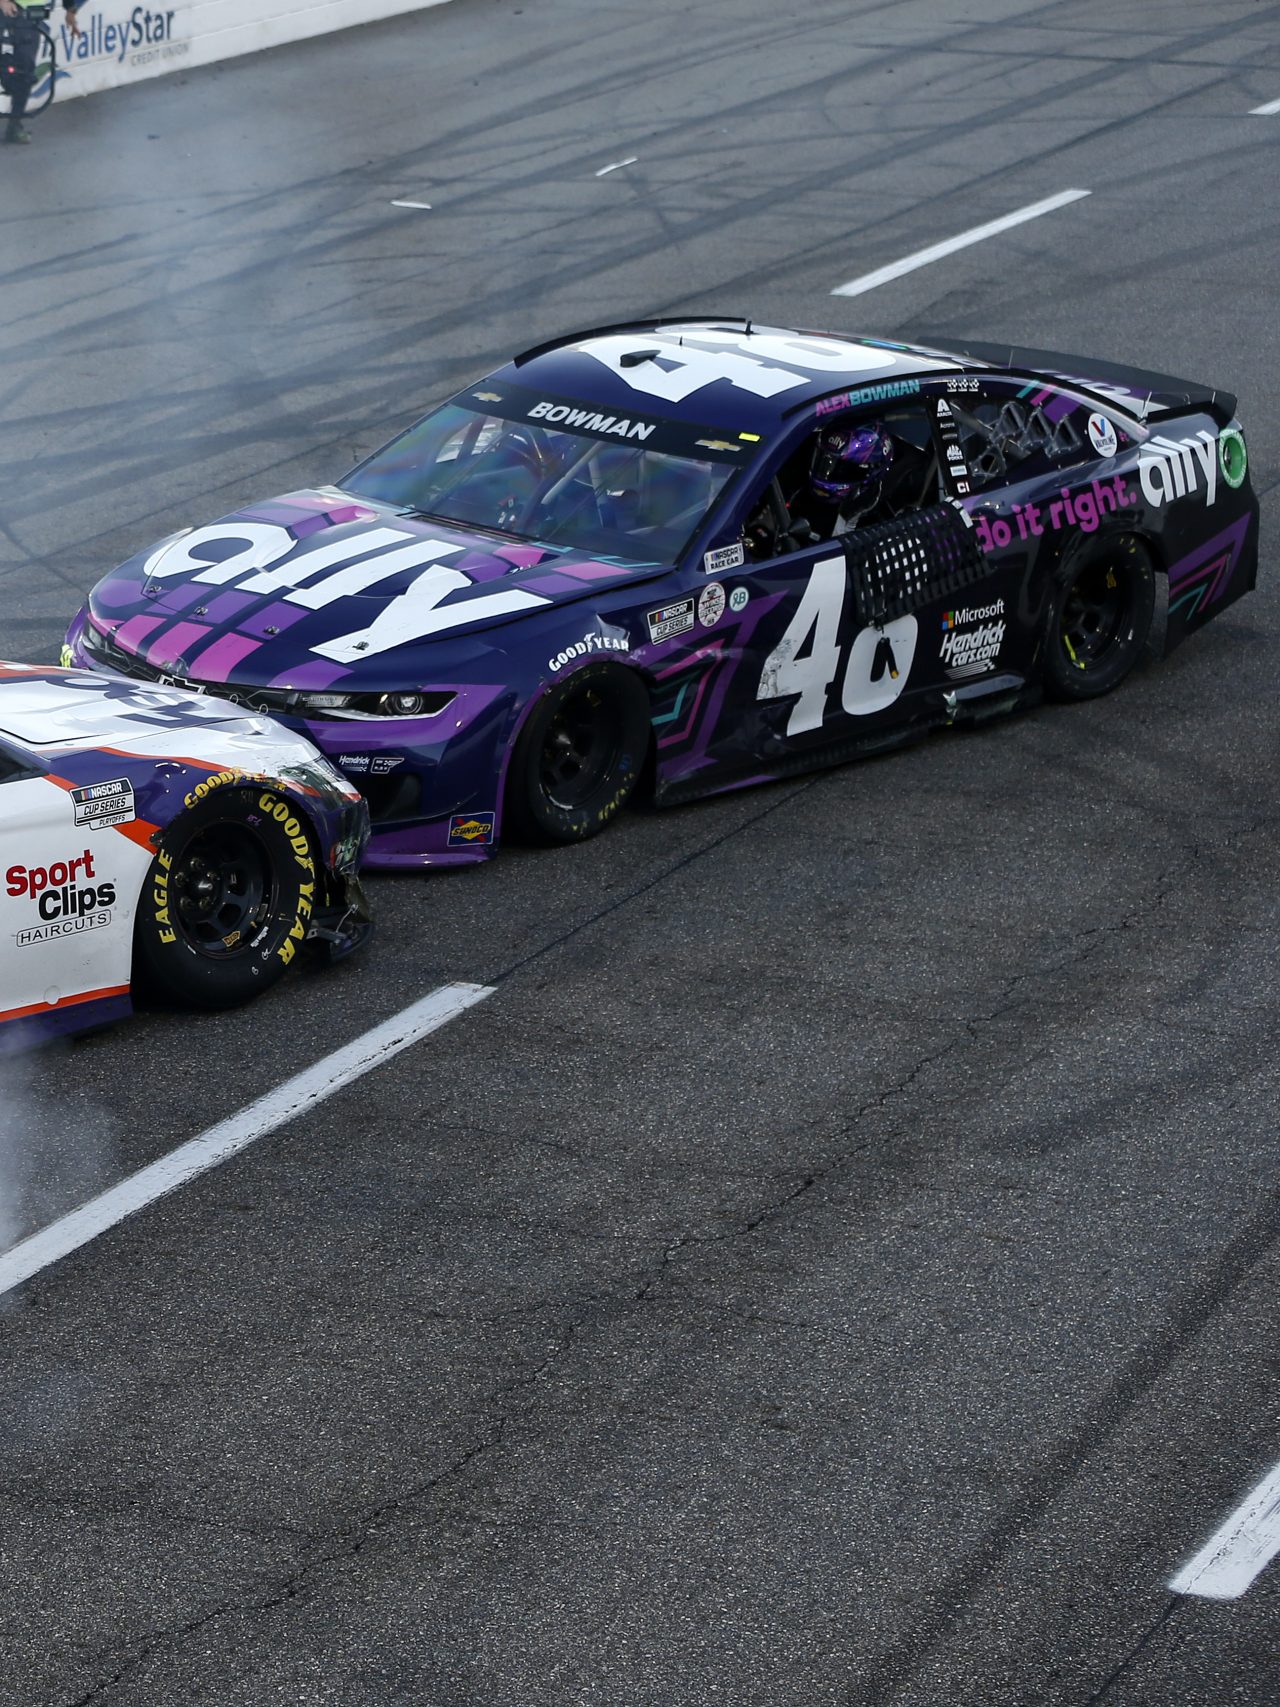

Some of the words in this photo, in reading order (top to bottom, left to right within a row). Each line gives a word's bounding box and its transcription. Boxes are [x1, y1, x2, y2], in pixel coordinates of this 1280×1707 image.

[527, 401, 656, 441] BOWMAN
[828, 436, 846, 450] ally
[1137, 430, 1217, 508] ally
[975, 515, 1011, 553] do
[1012, 503, 1044, 540] it
[1049, 475, 1137, 533] right.
[710, 559, 726, 570] RACE
[726, 556, 740, 566] CAR
[144, 522, 554, 664] ally
[955, 598, 1005, 625] Microsoft
[655, 624, 669, 636] CUP
[668, 617, 689, 632] SERIES
[939, 620, 1007, 663] Hendrick
[951, 643, 1001, 667] cars.com
[90, 782, 123, 798] NASCAR
[83, 803, 100, 816] CUP
[100, 797, 126, 812] SERIES
[99, 814, 126, 827] PLAYOFFS
[452, 824, 491, 836] SUNOCO
[6, 849, 95, 899] Sport
[38, 883, 116, 921] Clips
[153, 849, 177, 944] EAGLE
[20, 913, 108, 944] HAIRCUTS
